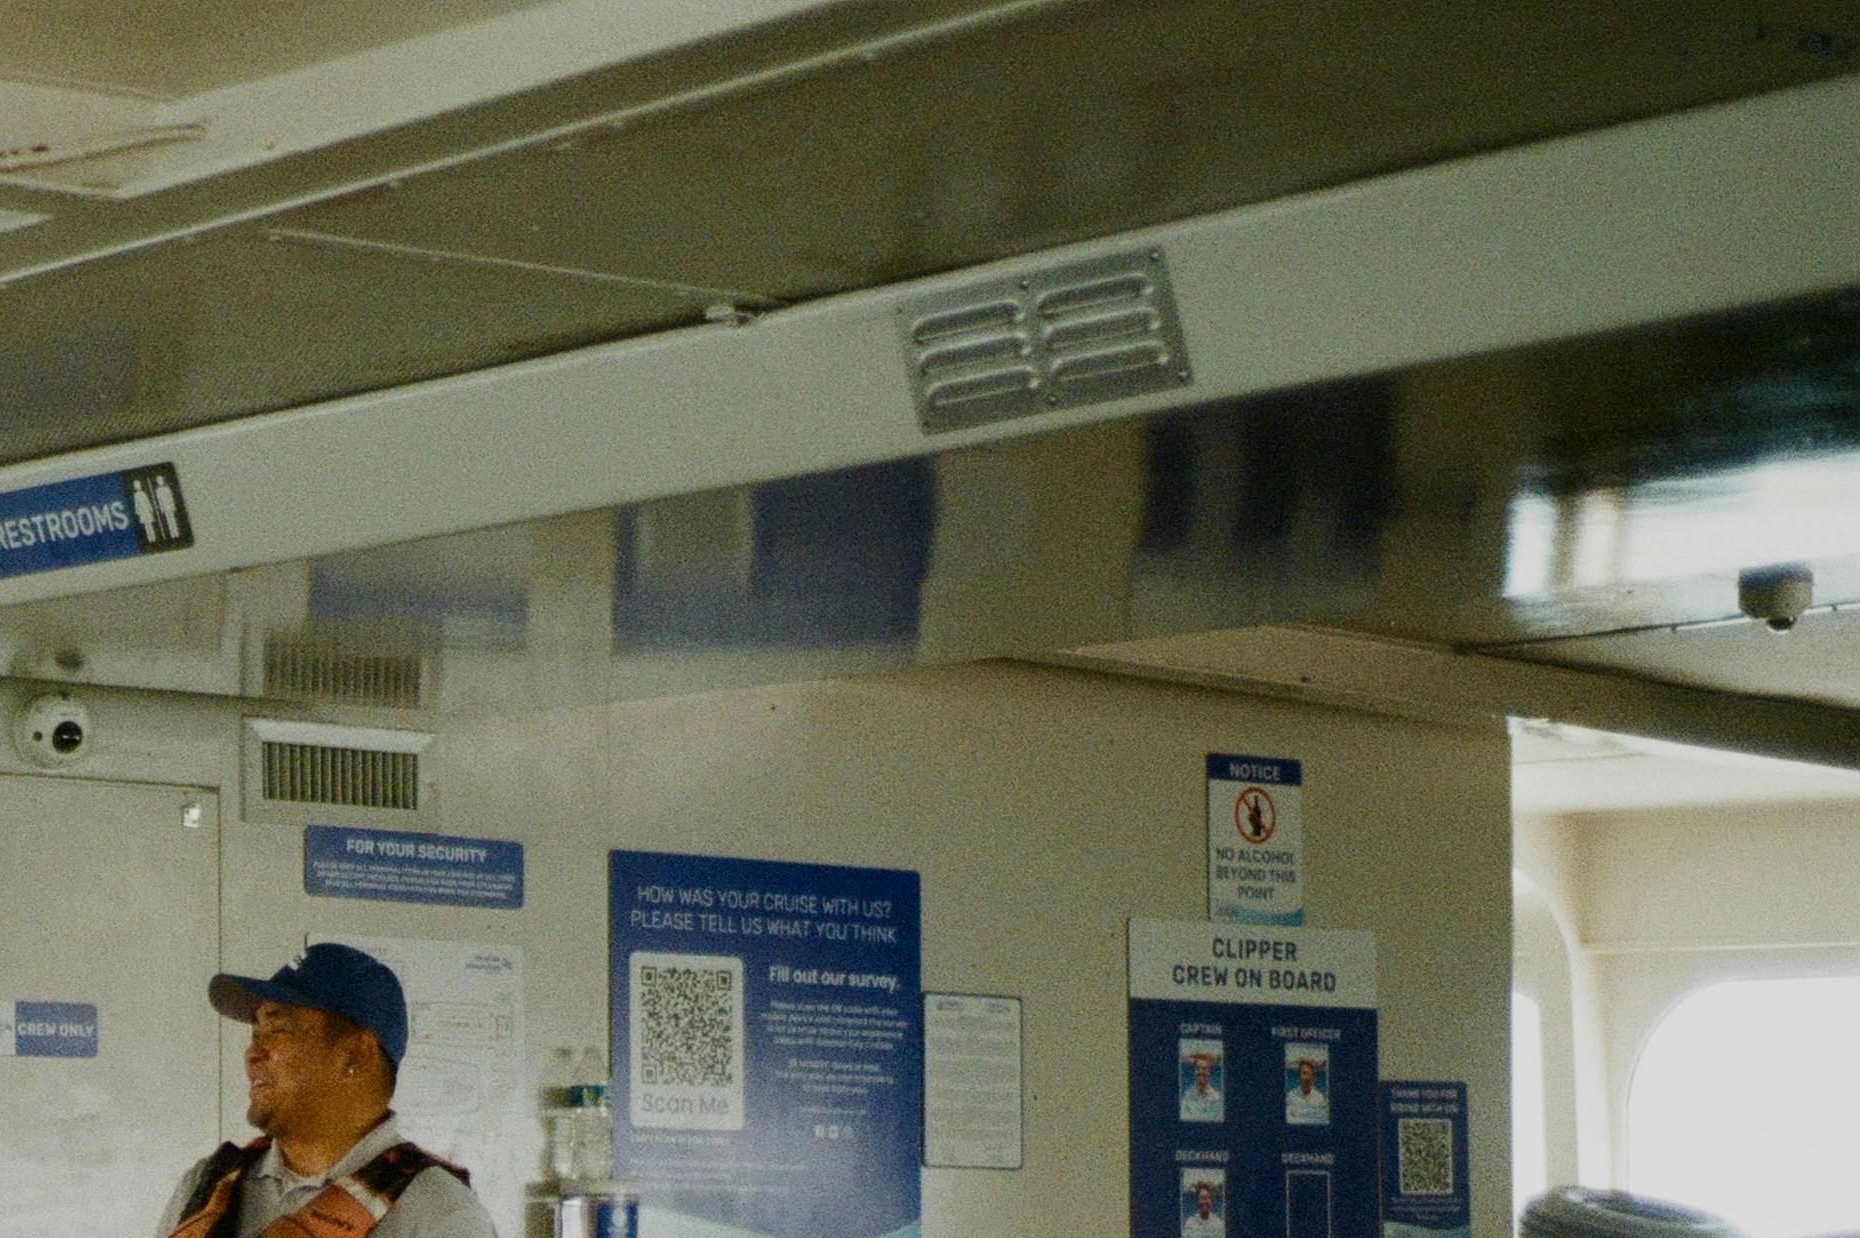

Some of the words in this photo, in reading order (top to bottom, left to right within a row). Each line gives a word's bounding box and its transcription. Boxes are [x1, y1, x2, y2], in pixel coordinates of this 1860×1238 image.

[1228, 763, 1281, 781] NOTICE
[346, 838, 375, 853] FOR
[377, 841, 416, 857] YOUR
[418, 844, 487, 862] SECURITY
[1215, 846, 1235, 861] NO
[1238, 848, 1296, 865] ALCOHOL
[1215, 866, 1267, 882] BEYOND
[1269, 869, 1297, 884] THIS
[637, 885, 673, 903] HOW
[677, 888, 713, 907] WAS
[716, 890, 760, 909] YOUR
[763, 893, 817, 914] CRUISE
[822, 898, 859, 916] WITH
[862, 900, 892, 918] US?
[1237, 886, 1275, 900] POINT
[630, 909, 692, 931] PLEASE
[698, 914, 737, 933] TELL
[740, 917, 762, 935] US
[765, 919, 811, 937] WHAT
[816, 922, 848, 941] YOU
[853, 924, 898, 944] THINK
[1212, 936, 1299, 962] CLIPPER
[769, 966, 790, 982] Fill
[793, 969, 817, 984] out
[821, 972, 845, 986] our
[1172, 964, 1229, 985] CREW
[1234, 967, 1262, 988] ON
[1268, 969, 1337, 993] BOARD
[17, 1022, 56, 1037] CREW
[59, 1023, 95, 1038] ONLY
[1178, 1022, 1224, 1035] CAPTAIN
[1270, 1026, 1298, 1038] FIRST
[1300, 1027, 1342, 1040] OFFICER
[641, 1092, 693, 1115] Scan
[699, 1095, 730, 1116] Me
[1174, 1150, 1229, 1163] DECKHAND
[1280, 1152, 1335, 1165] DECKHAND
